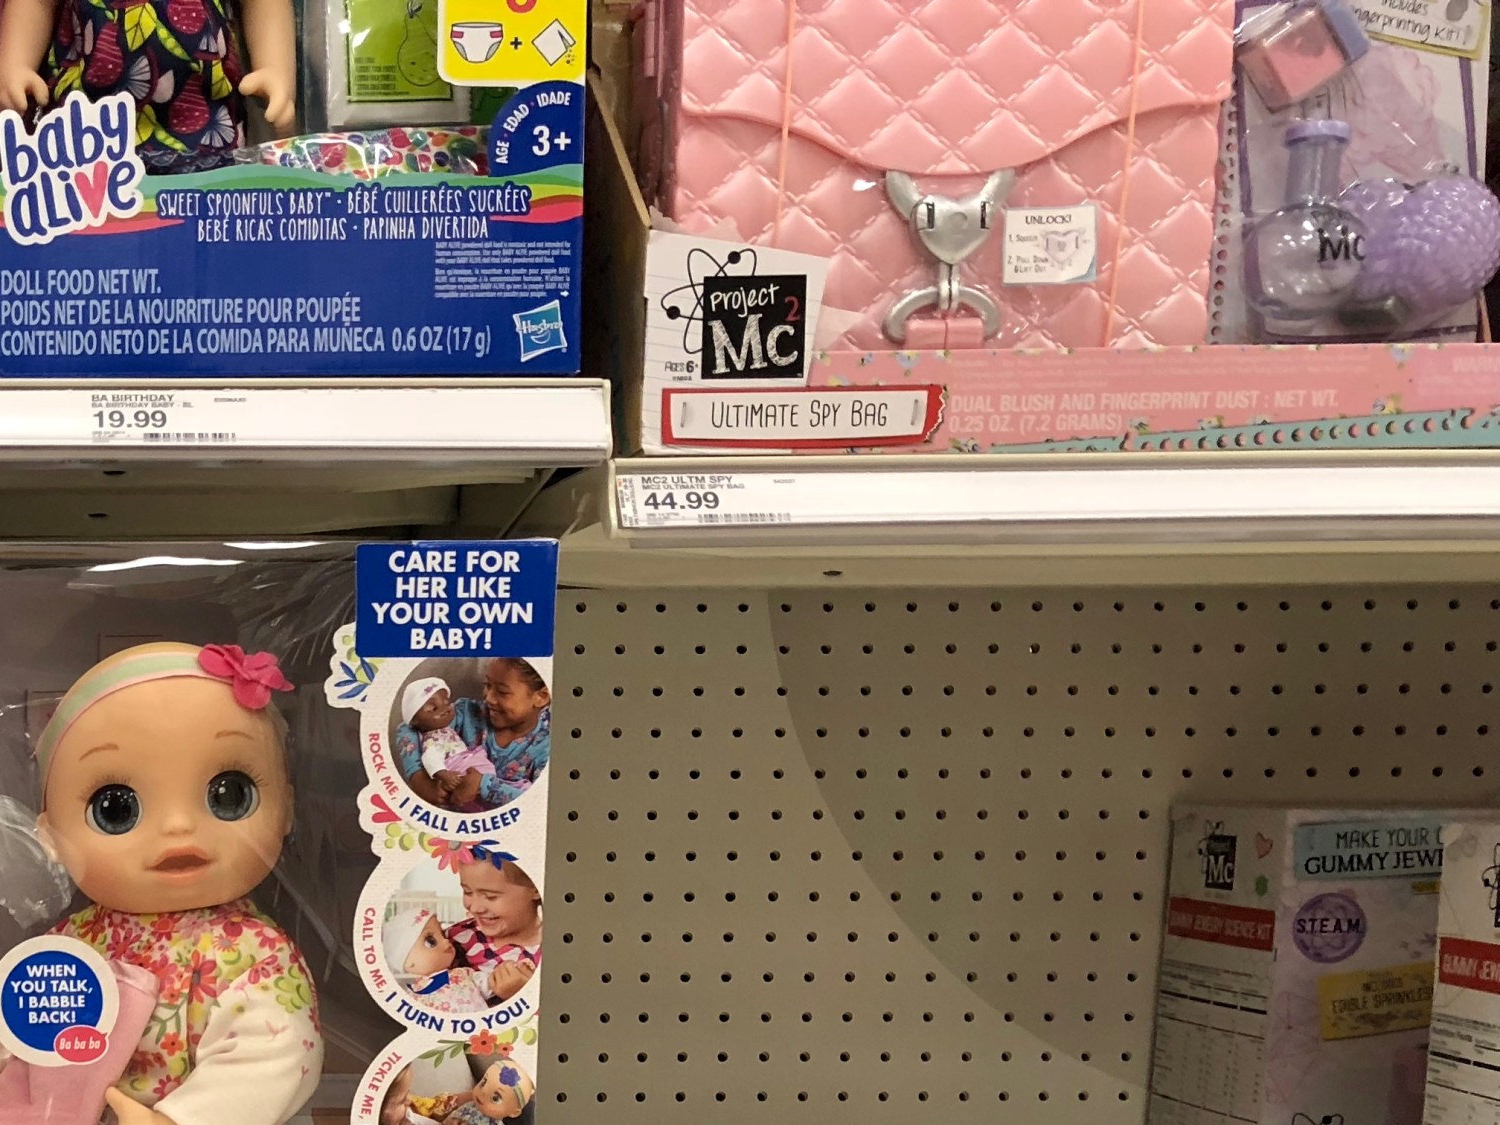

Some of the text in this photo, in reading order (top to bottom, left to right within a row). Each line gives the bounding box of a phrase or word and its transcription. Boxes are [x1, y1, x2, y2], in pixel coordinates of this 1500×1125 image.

[5, 99, 128, 185] baby
[532, 125, 572, 156] 3+
[159, 192, 200, 216] SWEET
[208, 190, 283, 217] SPOONFULS
[347, 185, 378, 214] BÉBÉ
[384, 184, 462, 213] CUILLERÉES
[469, 184, 531, 213] SUCRÉES
[1024, 213, 1073, 226] UNLOCK!
[707, 313, 799, 374] Mc
[91, 394, 174, 402] BA BIRTHDAY
[93, 410, 167, 428] 19.99
[711, 400, 889, 428] ULTIMATE SPY BAG
[641, 475, 733, 484] MC2 ULTM SPY
[644, 491, 720, 511] 44.99
[389, 550, 520, 573] CARE FOR
[396, 576, 511, 599] HER LIKE
[371, 602, 533, 624] YOUR OWN
[410, 628, 492, 650] BABY!
[409, 803, 522, 834] FALL ASLEEP
[1336, 827, 1429, 849] MAKE YOUR
[1303, 851, 1390, 875] GUMMY
[26, 964, 76, 977] WHEN
[10, 979, 94, 995] YOU TALK,
[28, 995, 86, 1009] BABBLE
[28, 1011, 76, 1024] BACK!
